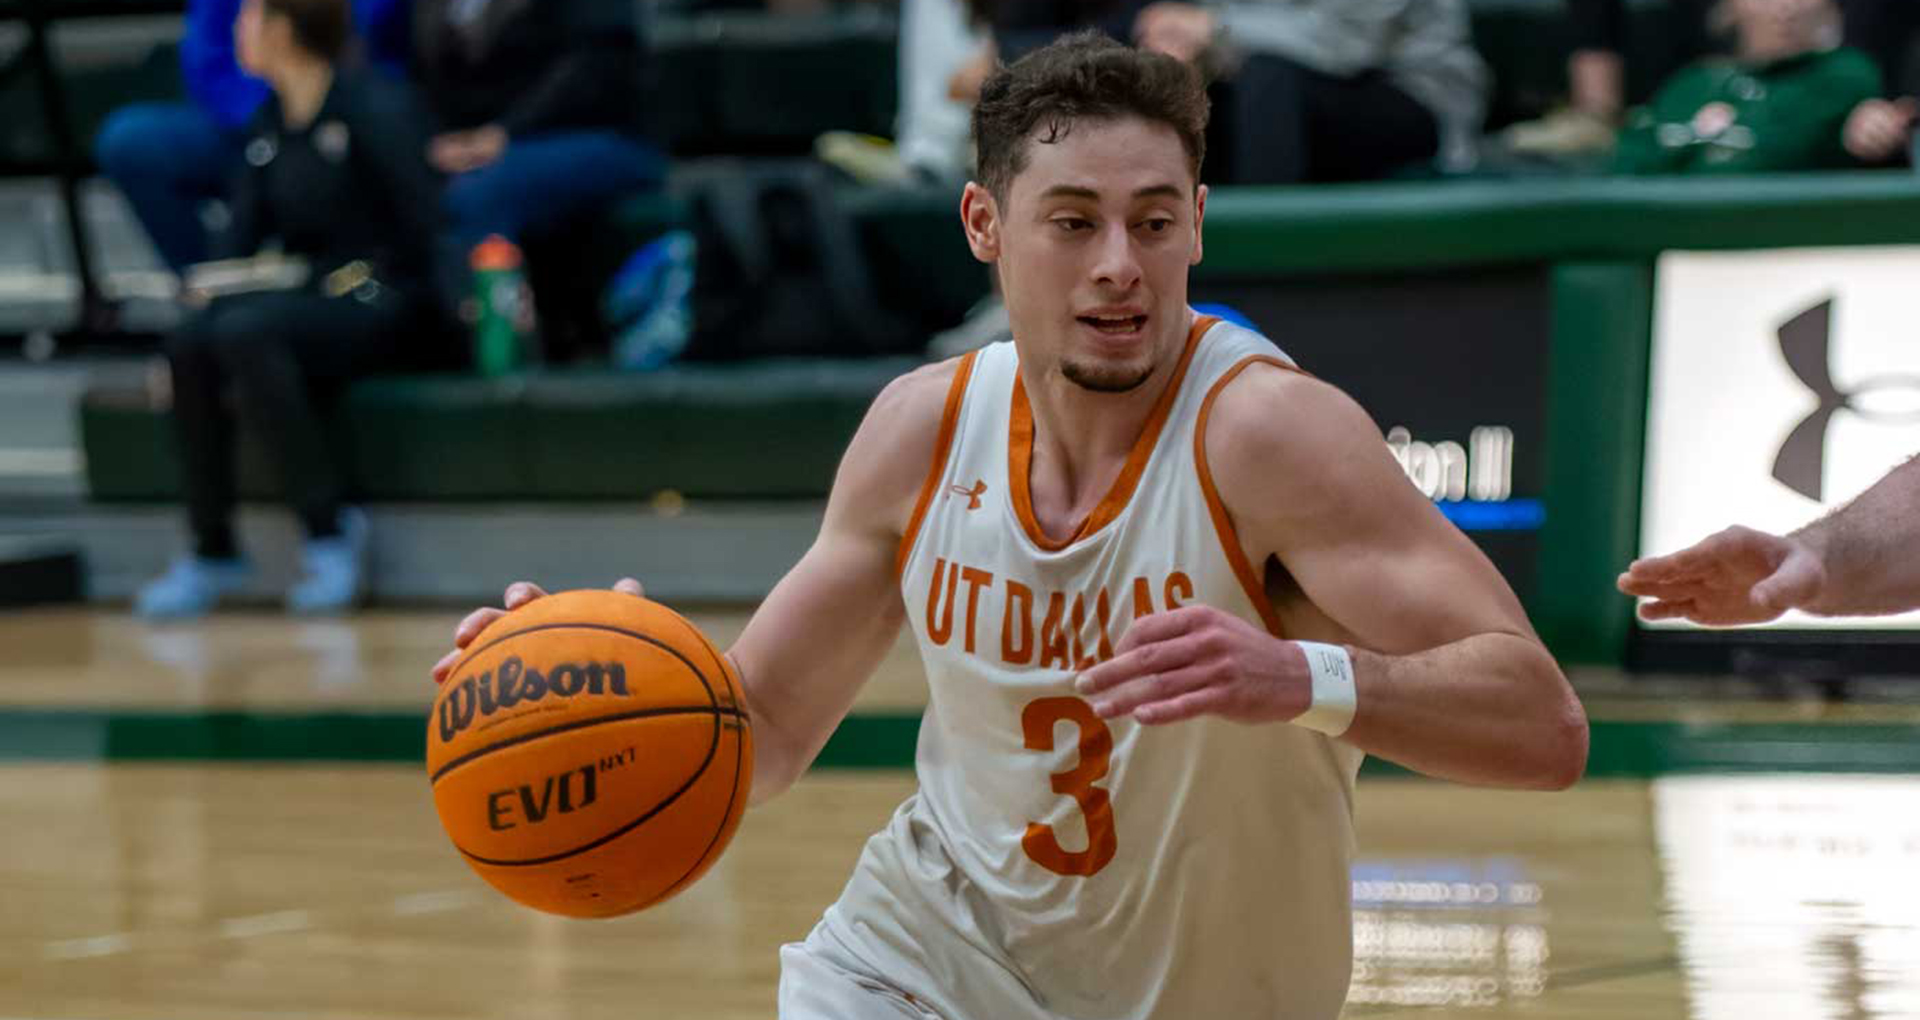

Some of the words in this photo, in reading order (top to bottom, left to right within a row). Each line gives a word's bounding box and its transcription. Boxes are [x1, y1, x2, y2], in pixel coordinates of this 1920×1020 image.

[926, 558, 993, 654] UT
[439, 656, 630, 743] Wilson
[487, 763, 597, 832] EVO
[600, 748, 637, 772] NXT
[1021, 696, 1117, 877] 3
